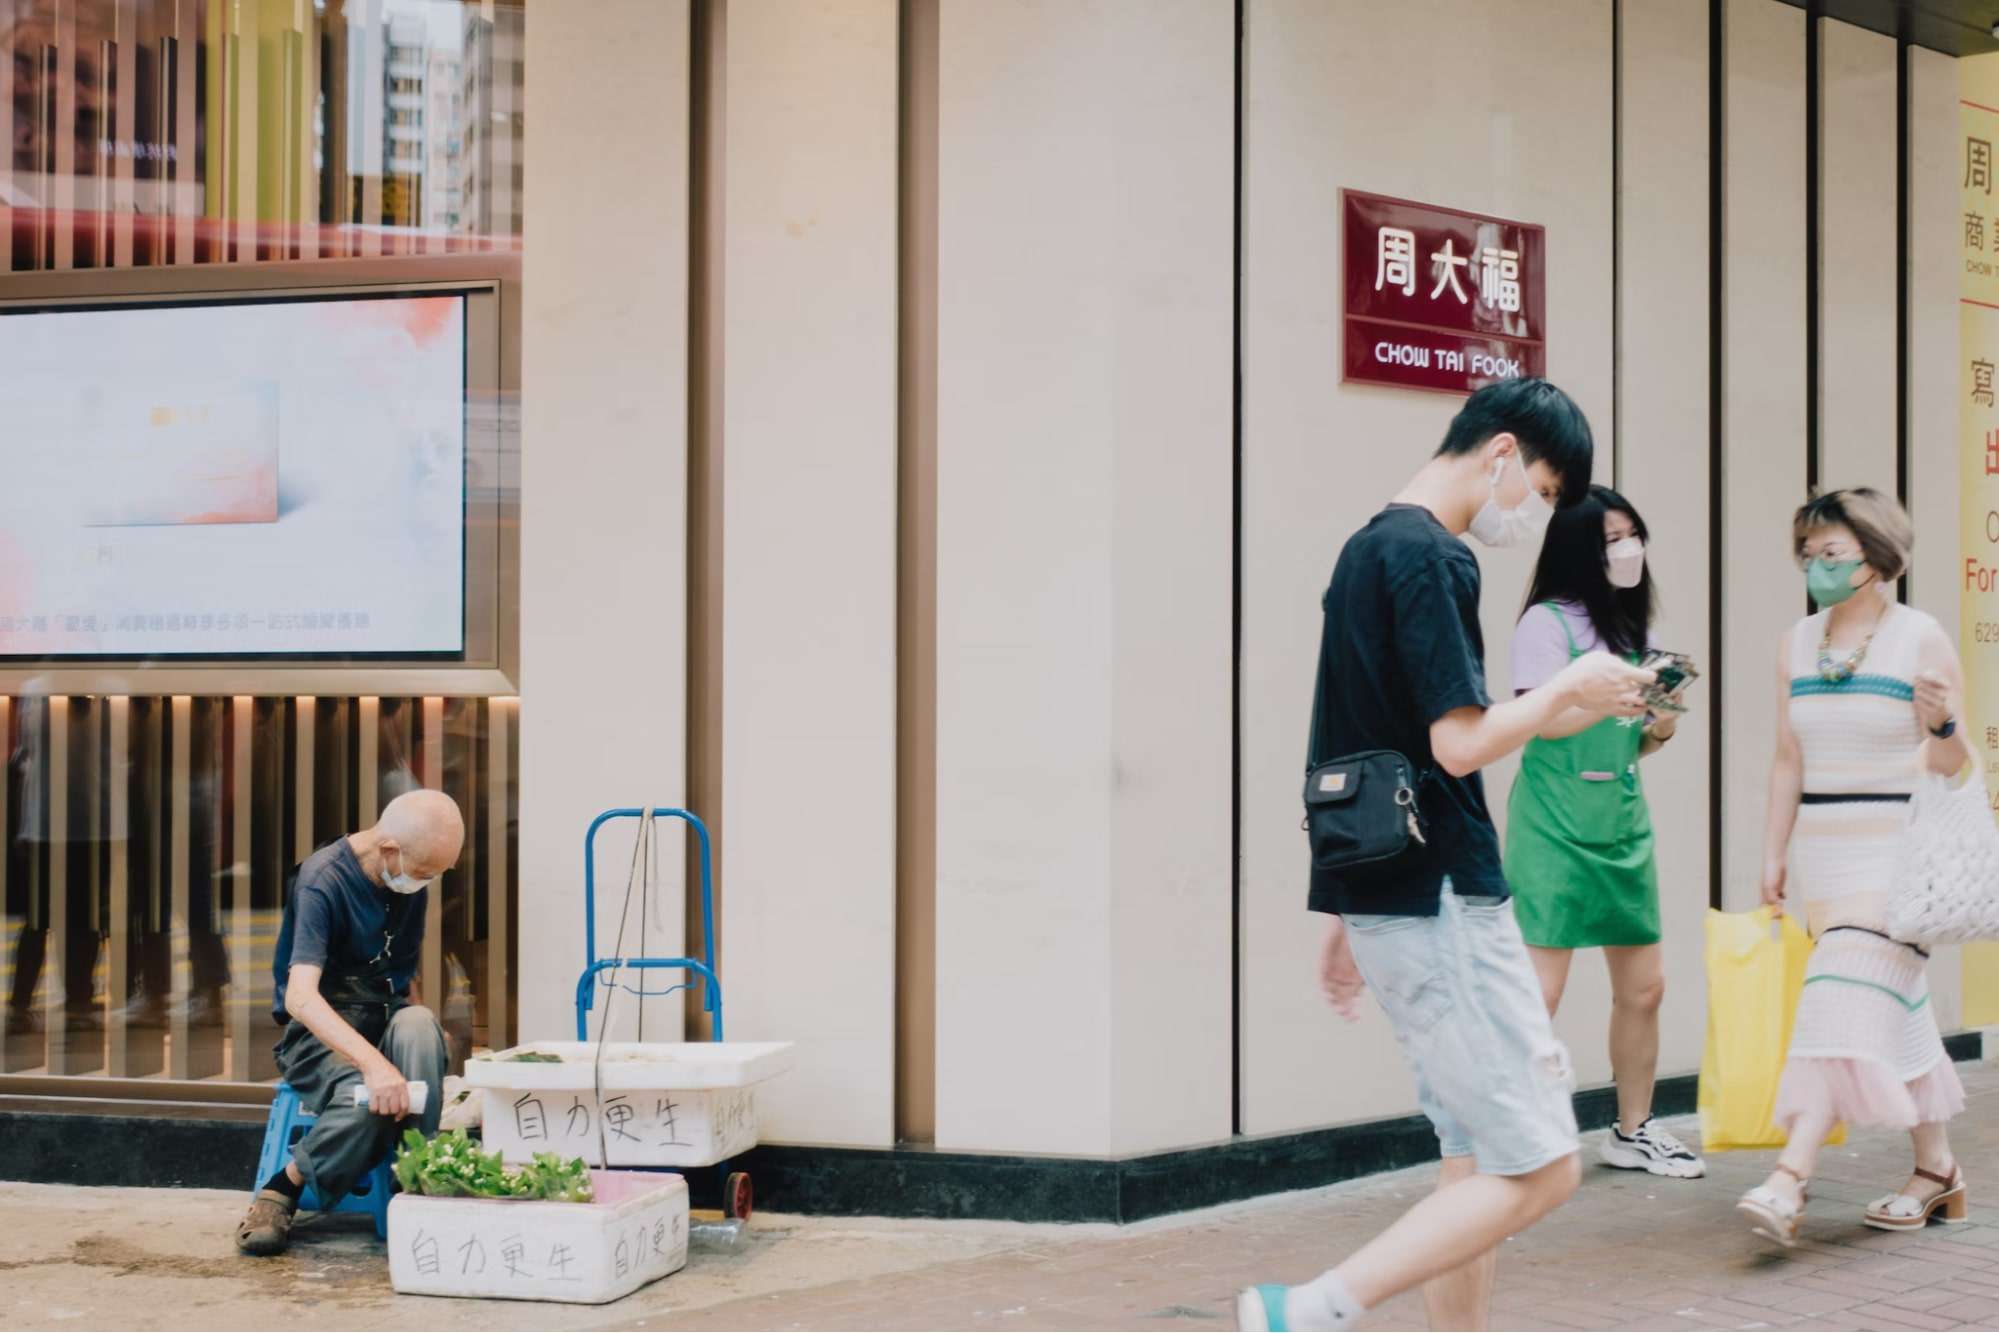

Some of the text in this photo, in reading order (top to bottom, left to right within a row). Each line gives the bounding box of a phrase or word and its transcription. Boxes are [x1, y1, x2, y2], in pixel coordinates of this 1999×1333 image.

[1964, 136, 1992, 196] 周
[1375, 226, 1520, 312] 周大福
[1375, 342, 1520, 378] CHOW TAI FOOK
[513, 1091, 694, 1148] 自力更生
[411, 1228, 583, 1283] 自力更生
